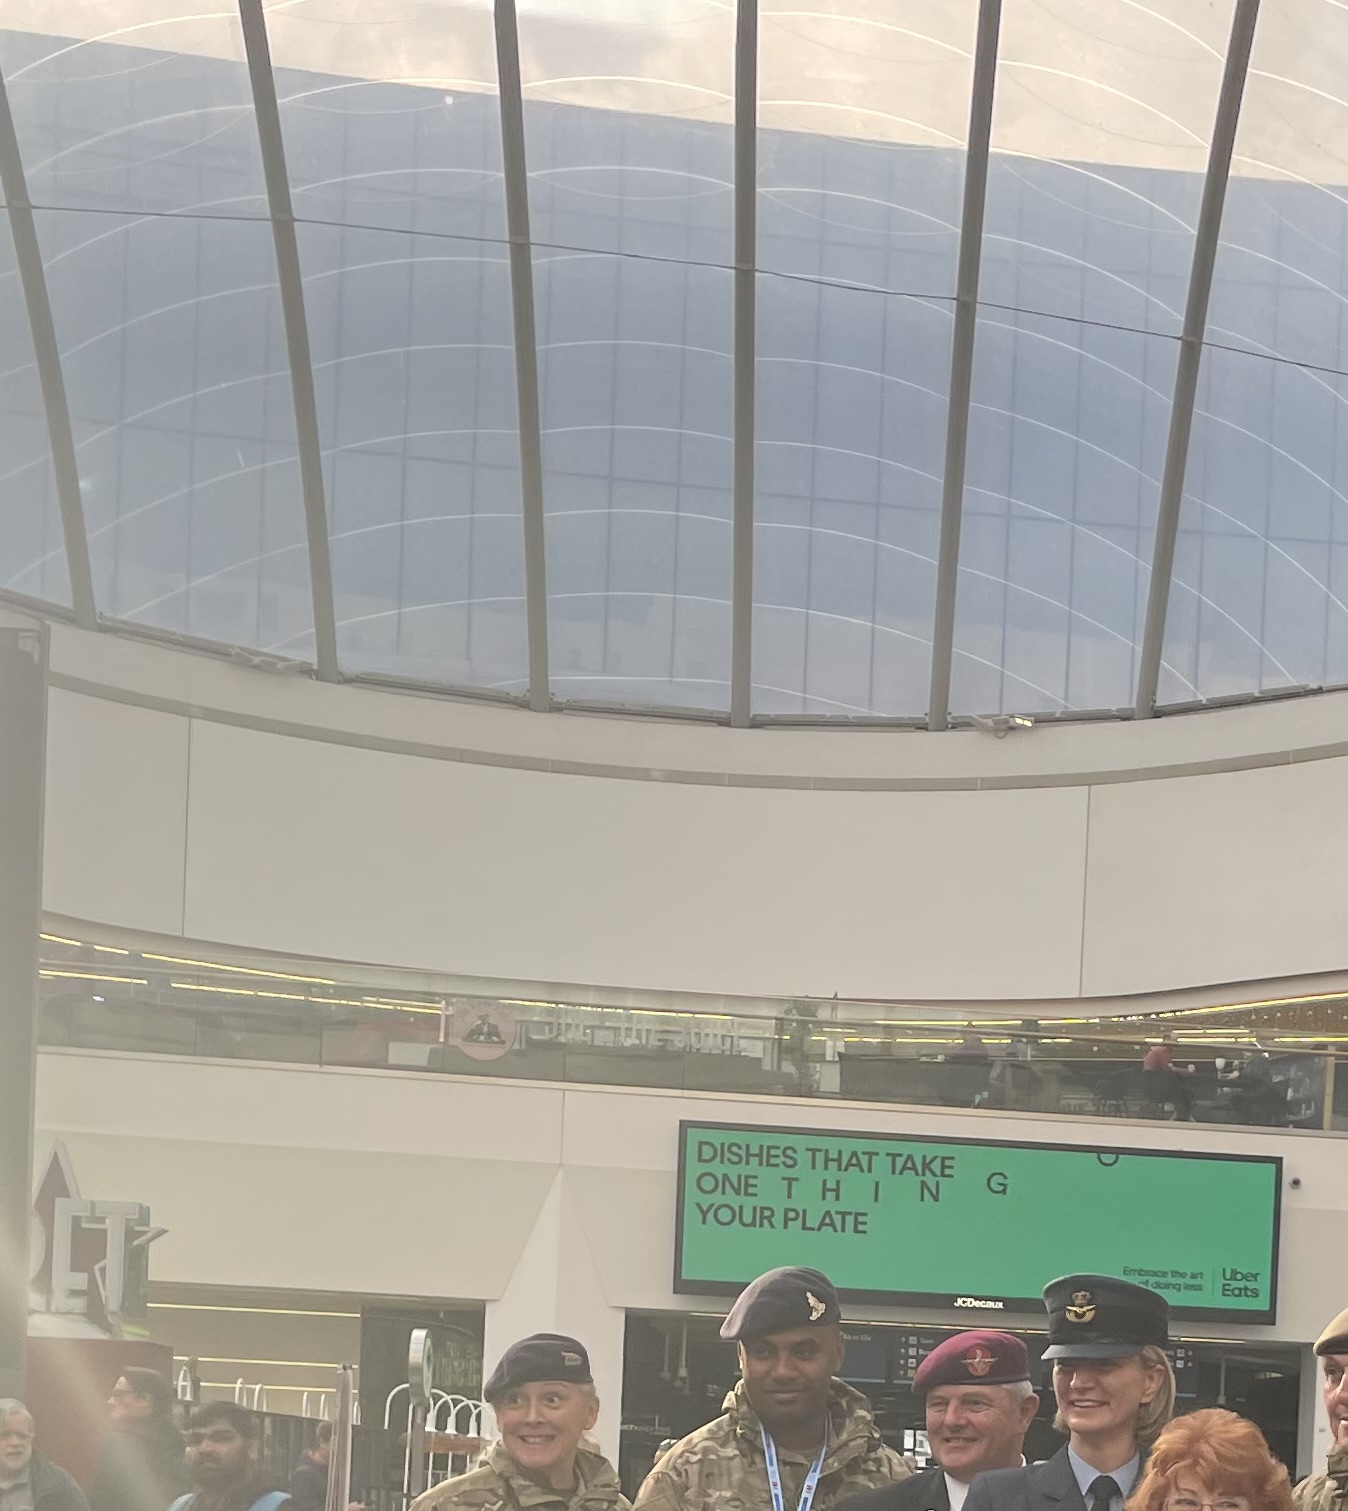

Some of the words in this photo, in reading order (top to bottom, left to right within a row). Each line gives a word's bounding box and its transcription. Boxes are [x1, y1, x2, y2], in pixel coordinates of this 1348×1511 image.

[696, 1140, 799, 1169] DISHES
[805, 1147, 880, 1175] THAT
[885, 1152, 956, 1179] TAKE
[695, 1171, 759, 1198] ONE
[695, 1201, 776, 1230] YOUR
[782, 1206, 869, 1235] PLATE
[1222, 1267, 1261, 1283] Uber
[1221, 1283, 1260, 1299] Eats
